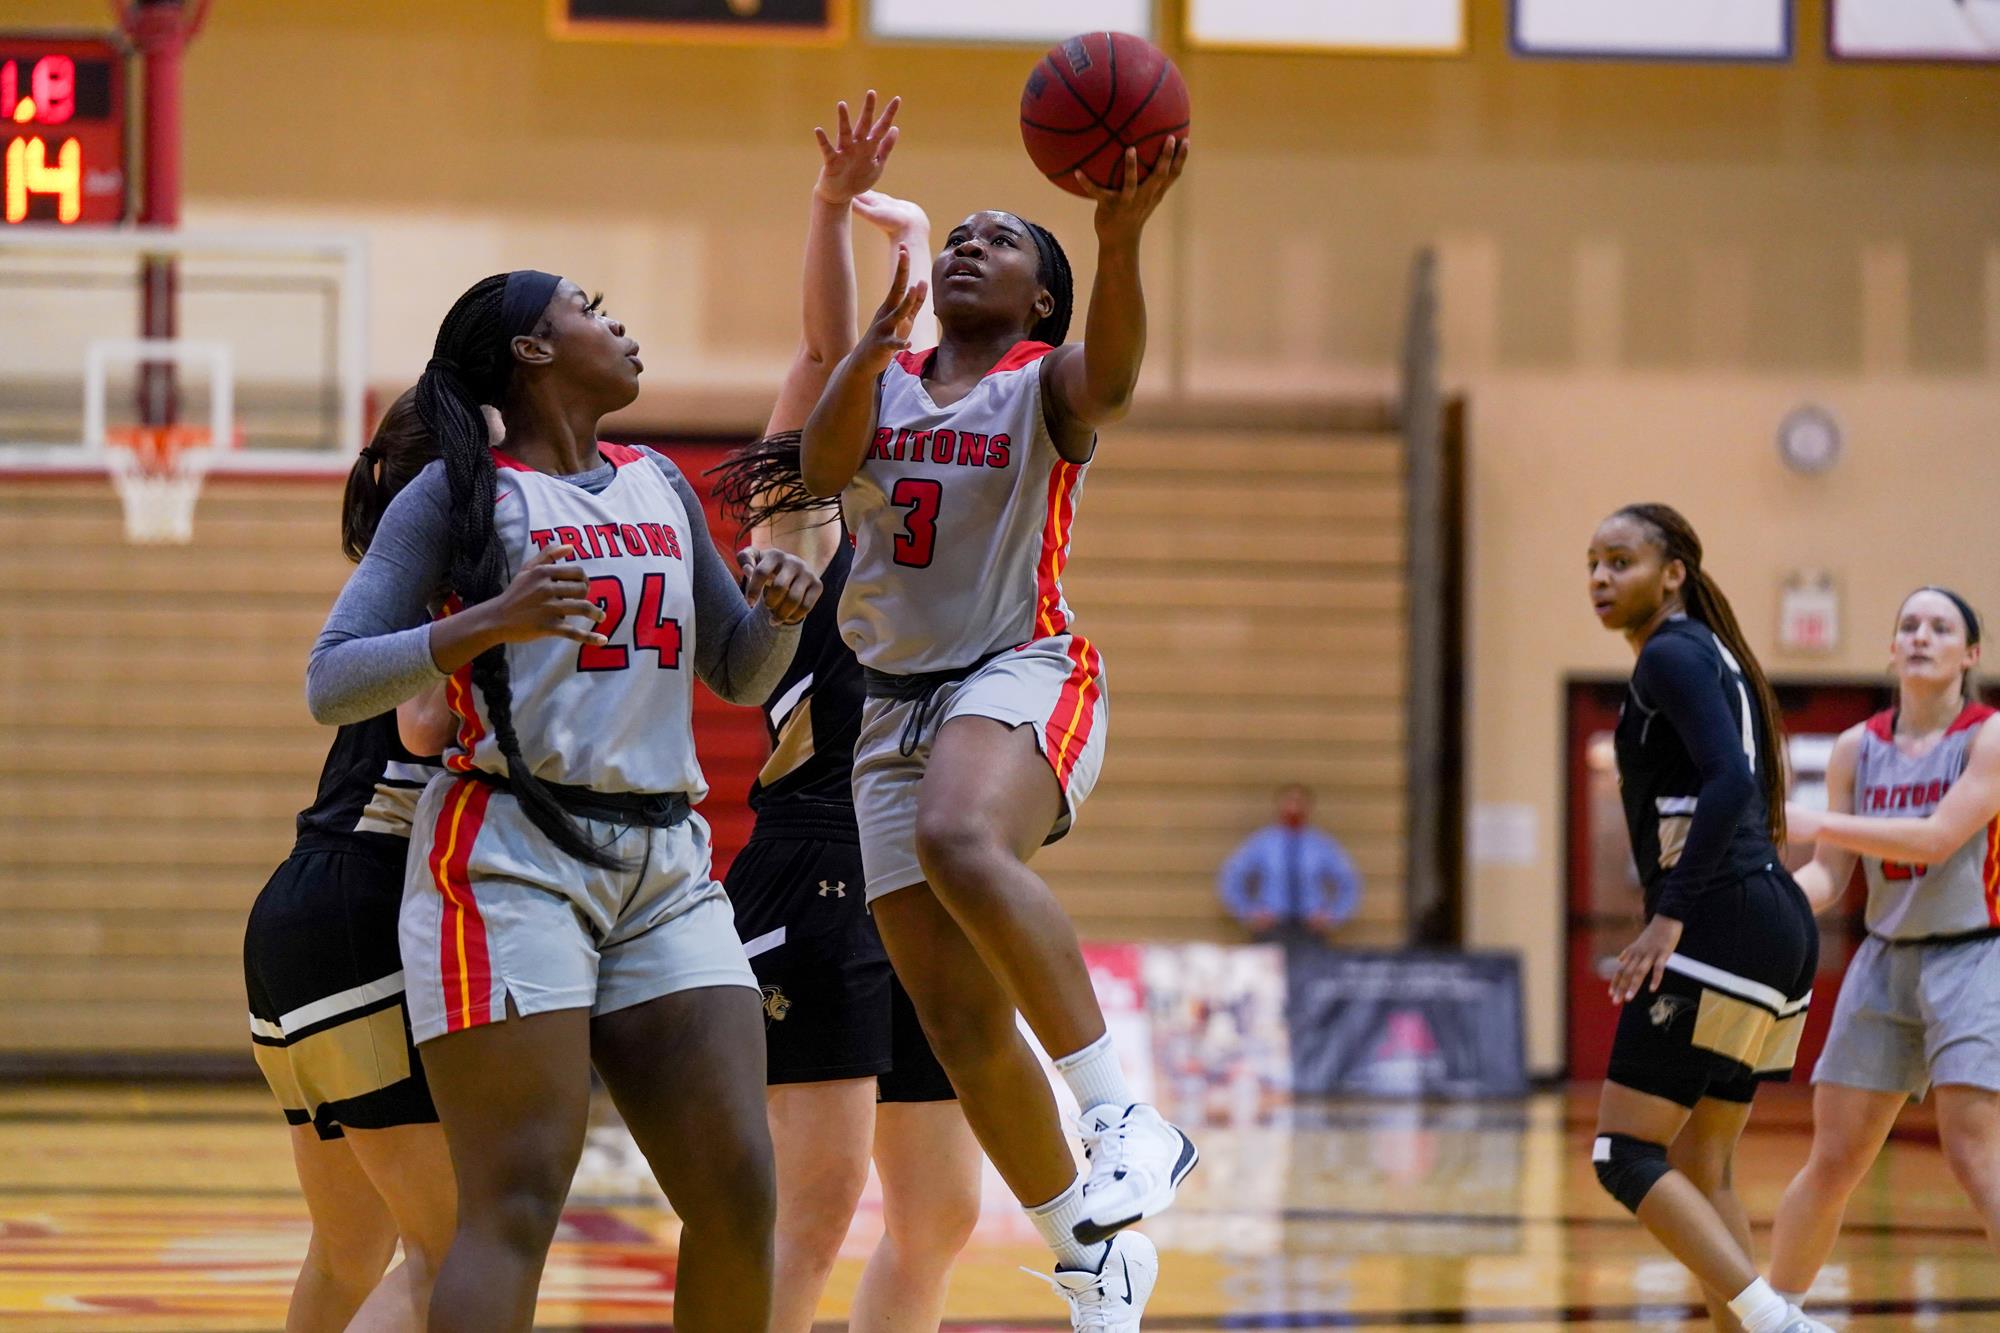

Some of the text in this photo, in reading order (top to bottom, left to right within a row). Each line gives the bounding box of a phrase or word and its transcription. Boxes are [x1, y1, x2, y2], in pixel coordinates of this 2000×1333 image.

[6, 136, 81, 224] 14
[866, 427, 1011, 468] RITONS
[891, 477, 943, 569] 3
[577, 572, 682, 672] 24
